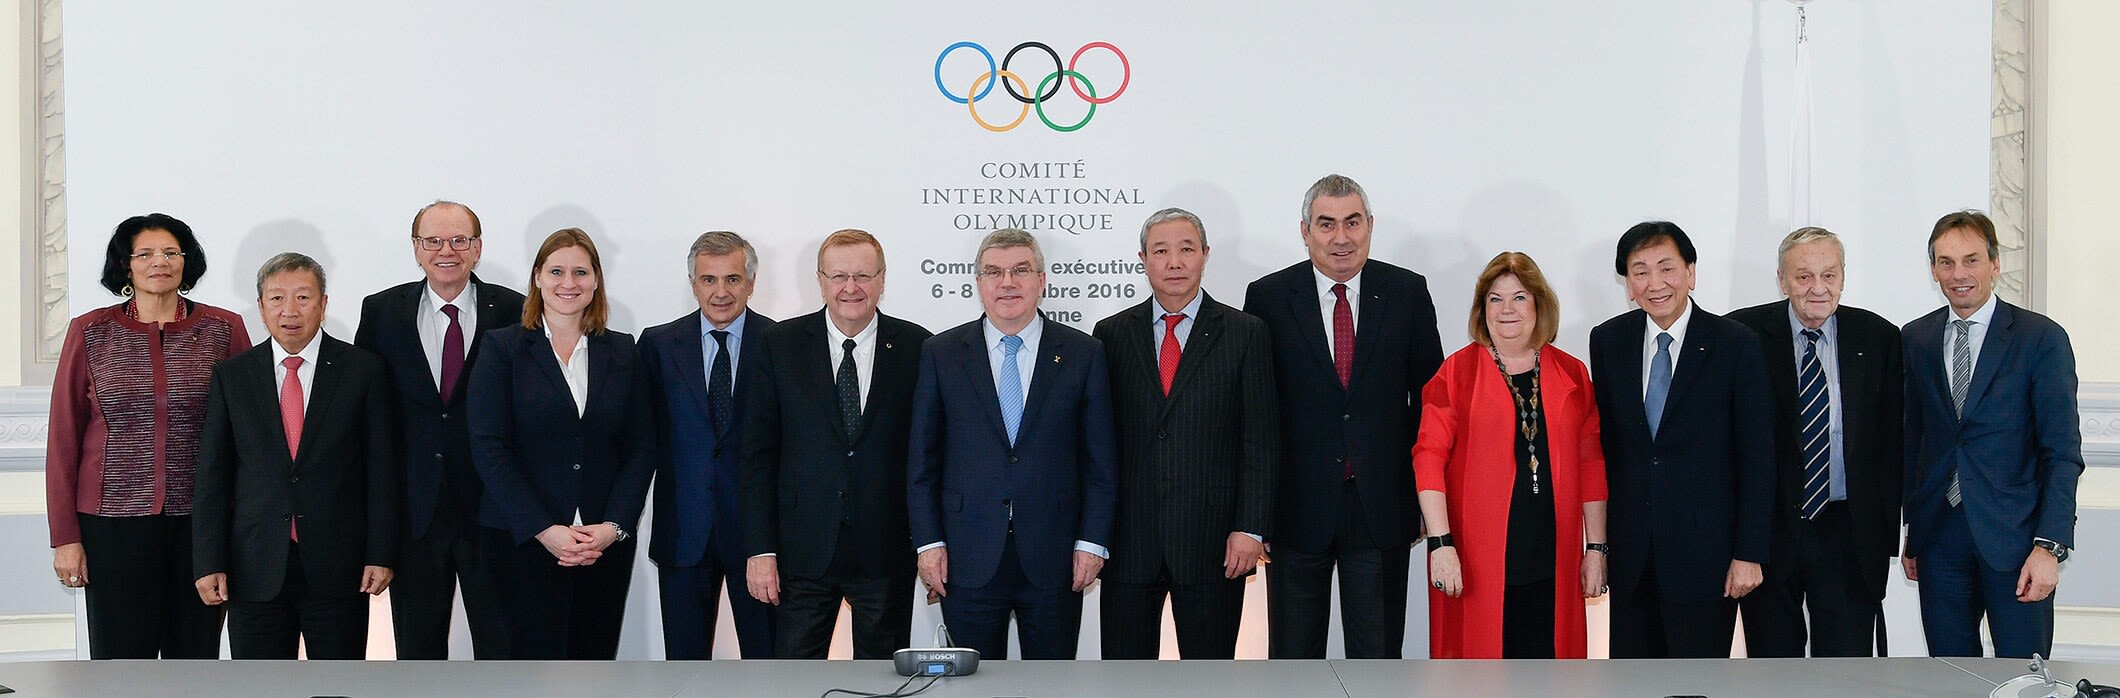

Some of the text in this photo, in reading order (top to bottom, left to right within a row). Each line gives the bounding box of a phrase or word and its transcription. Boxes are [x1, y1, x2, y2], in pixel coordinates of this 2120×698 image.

[981, 159, 1086, 179] COMITÉ
[921, 188, 1145, 205] INTERNATIONAL
[953, 213, 1113, 235] OLYMPIQUE
[1051, 259, 1145, 274] exécutive
[931, 283, 943, 298] 6
[961, 283, 973, 298] 8
[1087, 283, 1135, 298] 2016
